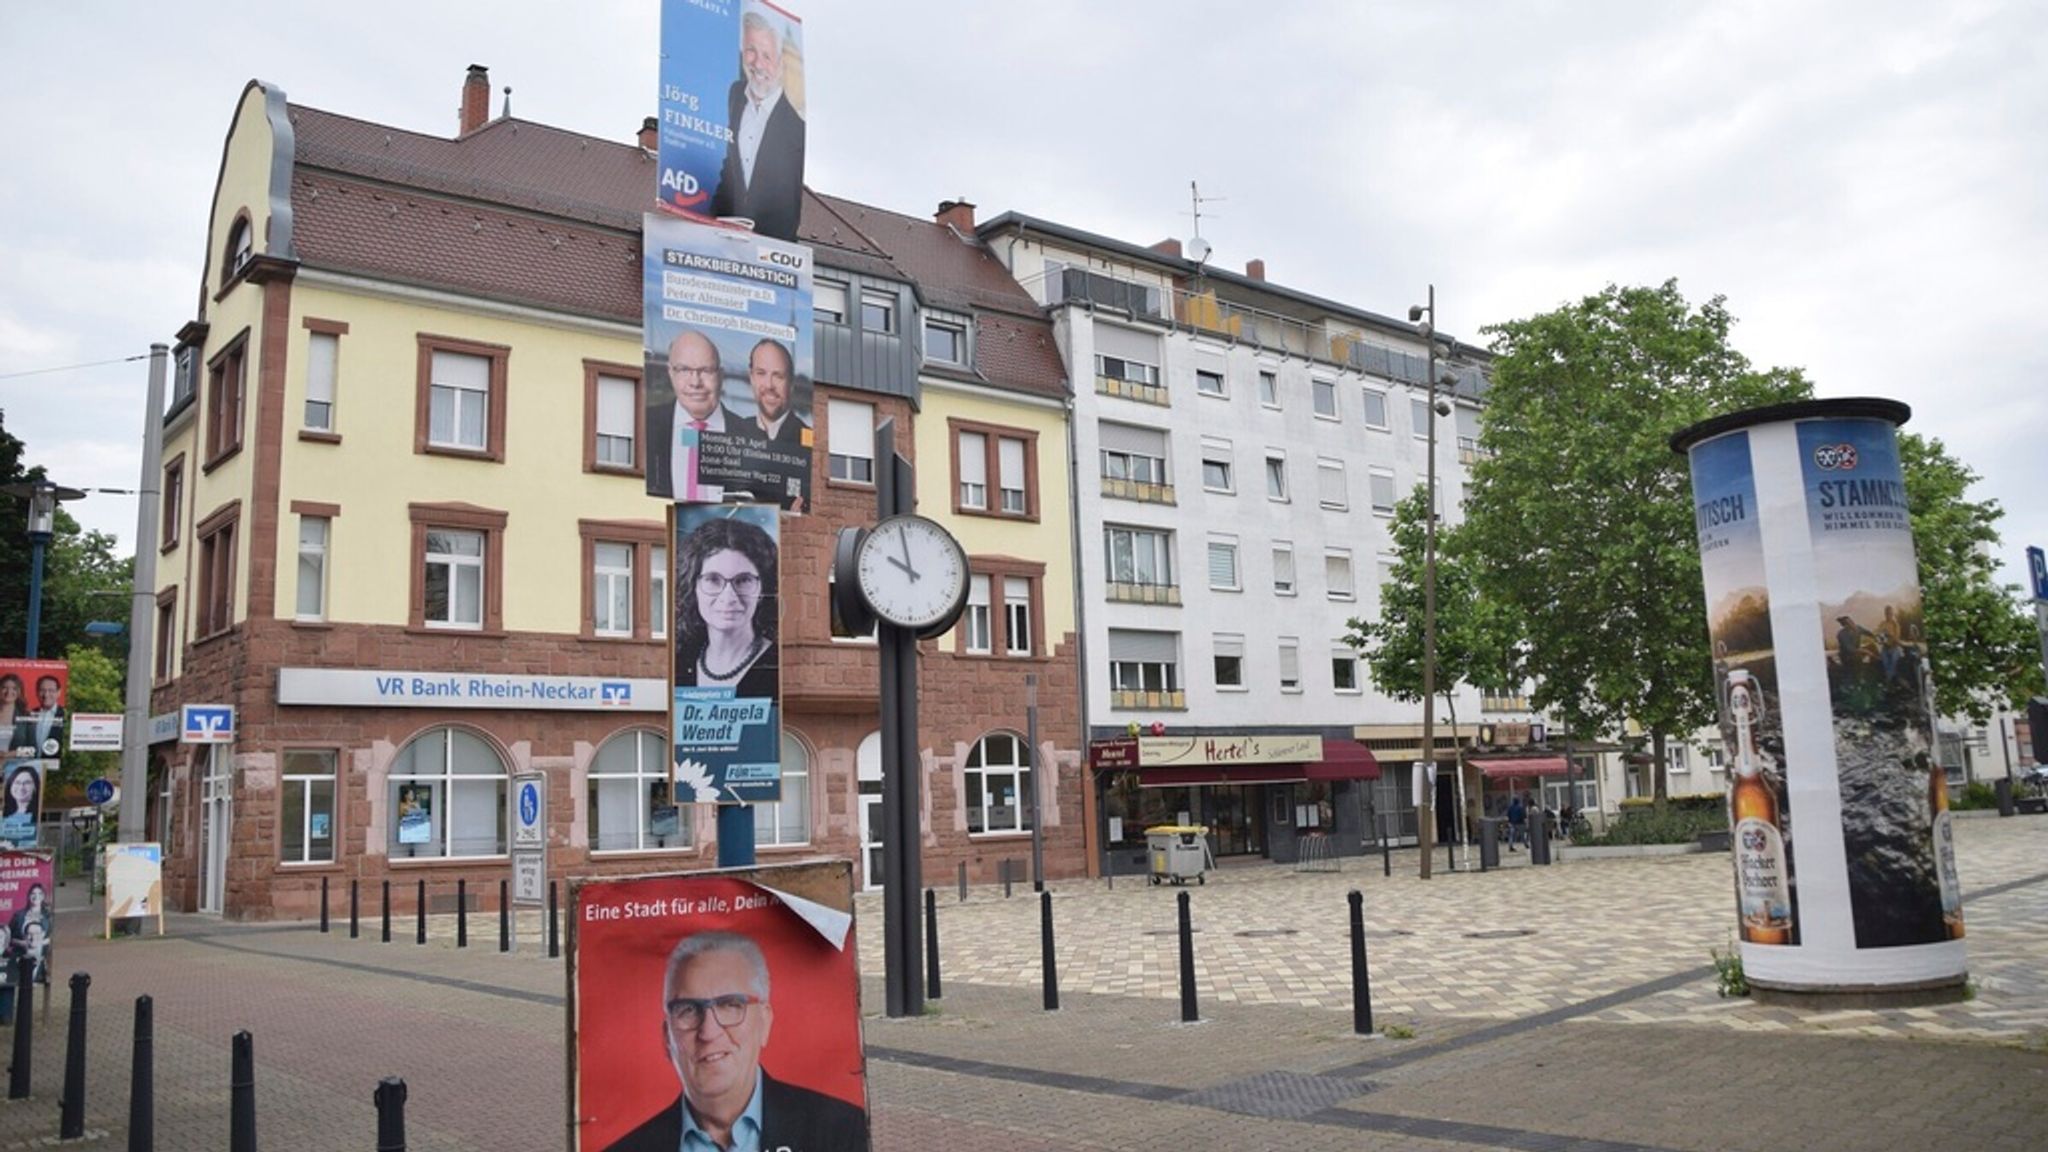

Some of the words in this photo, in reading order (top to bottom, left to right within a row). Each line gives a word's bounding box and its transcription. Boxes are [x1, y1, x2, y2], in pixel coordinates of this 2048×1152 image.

[664, 109, 734, 143] FINKLER
[661, 168, 698, 195] AfD
[667, 251, 796, 286] STARKBIERANSTICH
[770, 251, 803, 269] CDU
[666, 272, 751, 298] Bundesminister
[666, 287, 696, 299] Peter
[698, 291, 744, 309] Altmaier
[684, 310, 738, 328] Christoph
[701, 443, 725, 454] 19:00
[726, 446, 741, 455] Uhr
[749, 439, 768, 449] April
[376, 678, 404, 695] VR
[412, 678, 461, 697] Bank
[468, 680, 597, 700] Rhein-Neckar
[683, 704, 703, 721] Dr.
[708, 704, 764, 723] Angela
[682, 724, 733, 741] Wendt
[585, 904, 621, 921] Eine
[624, 900, 668, 918] Stadt
[671, 898, 695, 914] für
[697, 896, 731, 914] alle,
[734, 893, 767, 911] Dein
